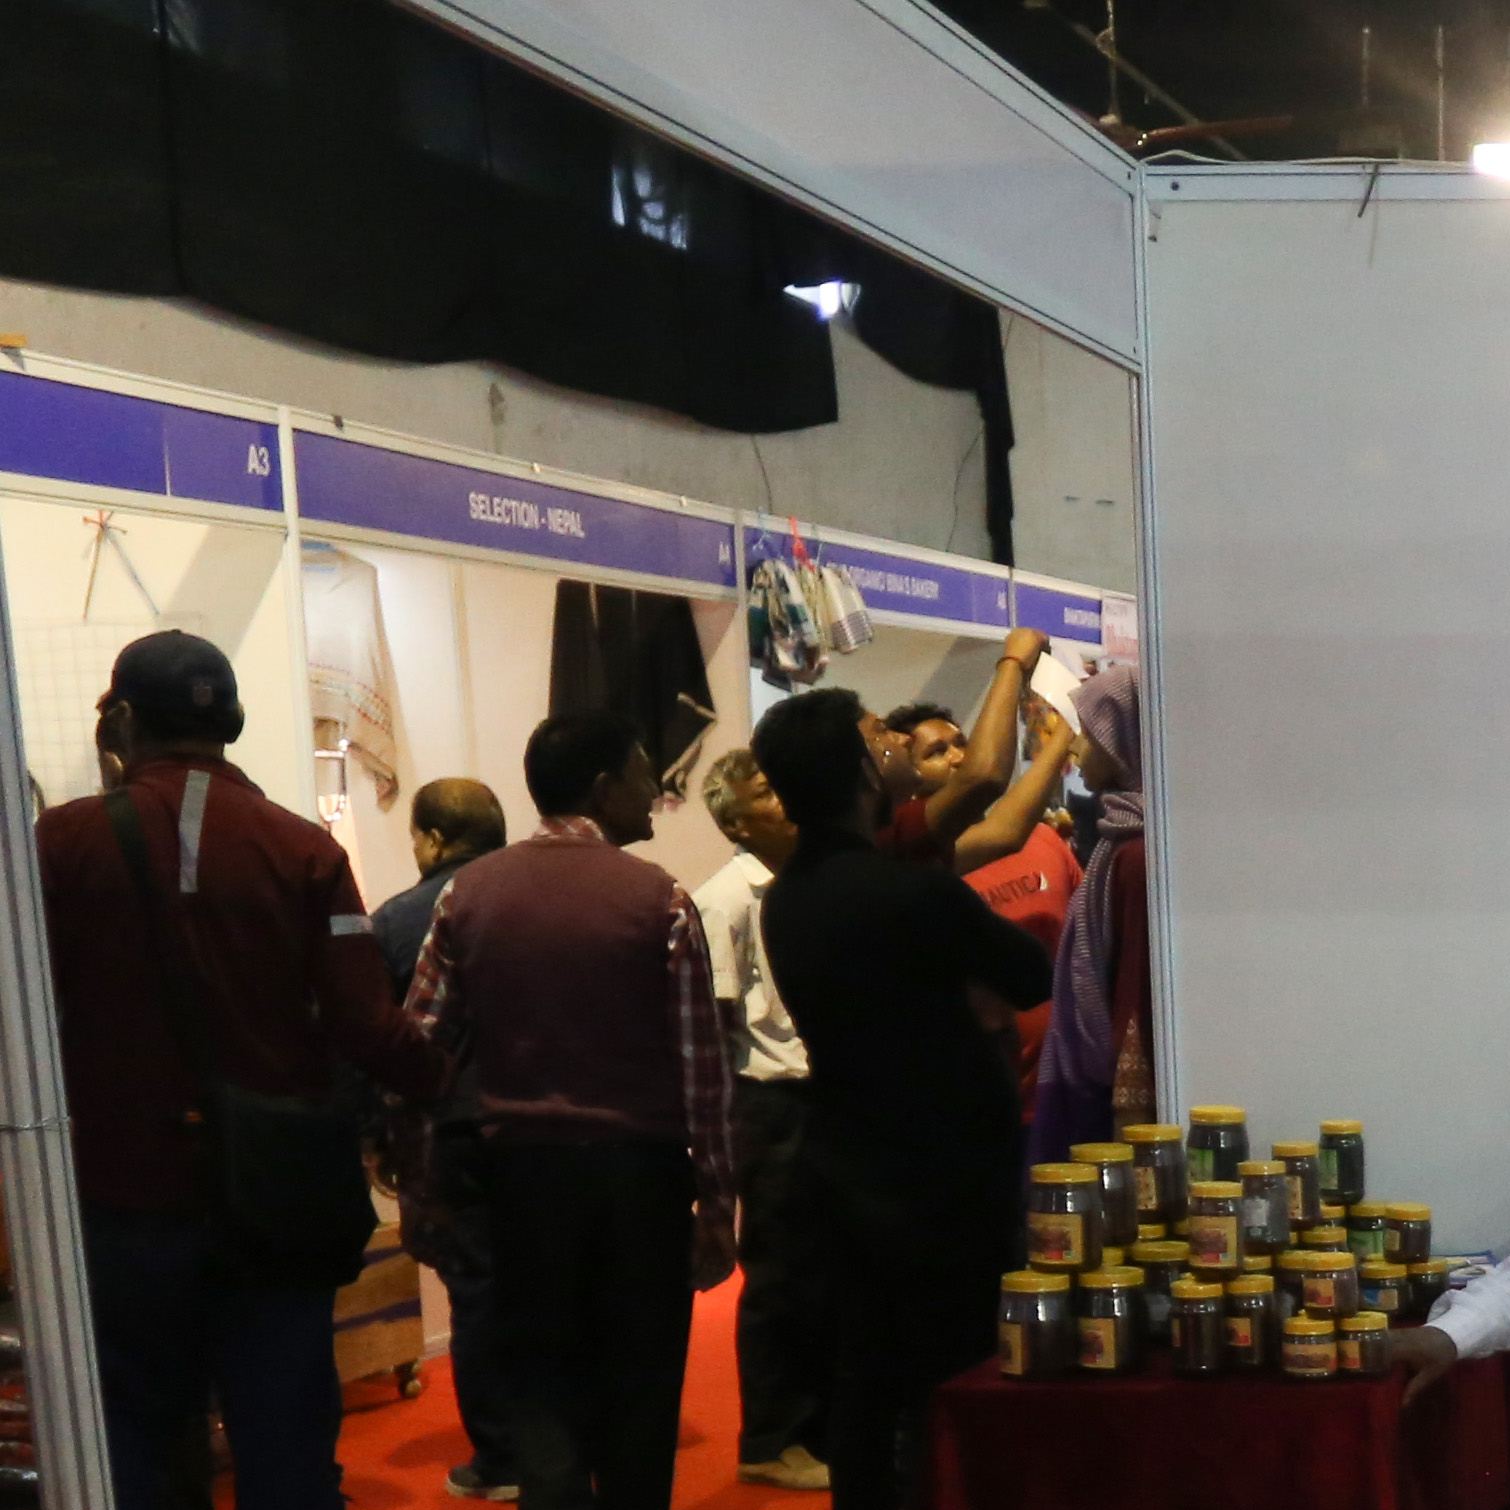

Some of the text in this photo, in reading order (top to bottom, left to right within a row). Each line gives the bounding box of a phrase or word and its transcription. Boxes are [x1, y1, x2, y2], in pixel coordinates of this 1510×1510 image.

[247, 442, 271, 477] A3
[468, 491, 539, 530] SELECTION
[547, 507, 586, 539] NEPAL
